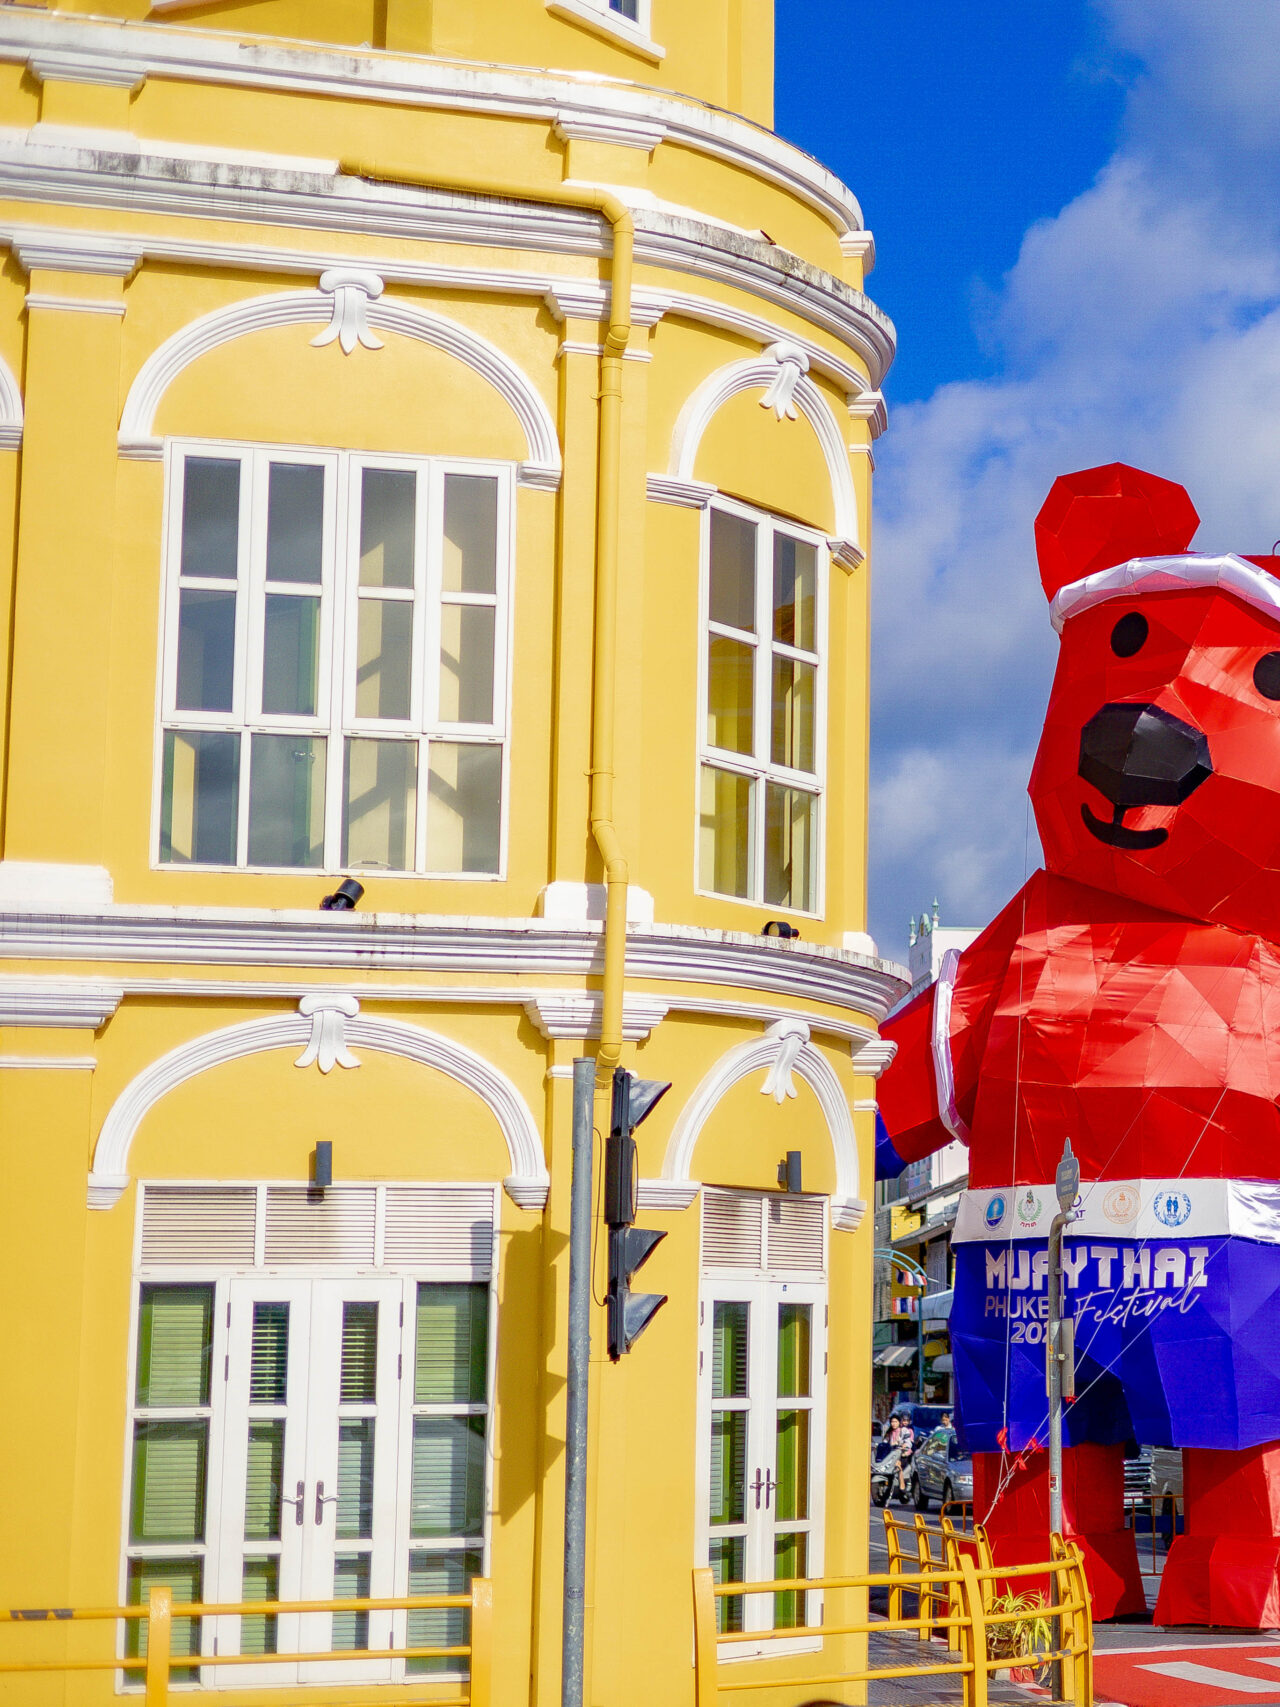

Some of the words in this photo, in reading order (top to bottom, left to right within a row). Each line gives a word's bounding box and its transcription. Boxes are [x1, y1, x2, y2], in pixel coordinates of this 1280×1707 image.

[985, 1246, 1209, 1291] MUAYTHAI
[985, 1295, 1066, 1319] PHUKE
[1073, 1271, 1202, 1339] Festival
